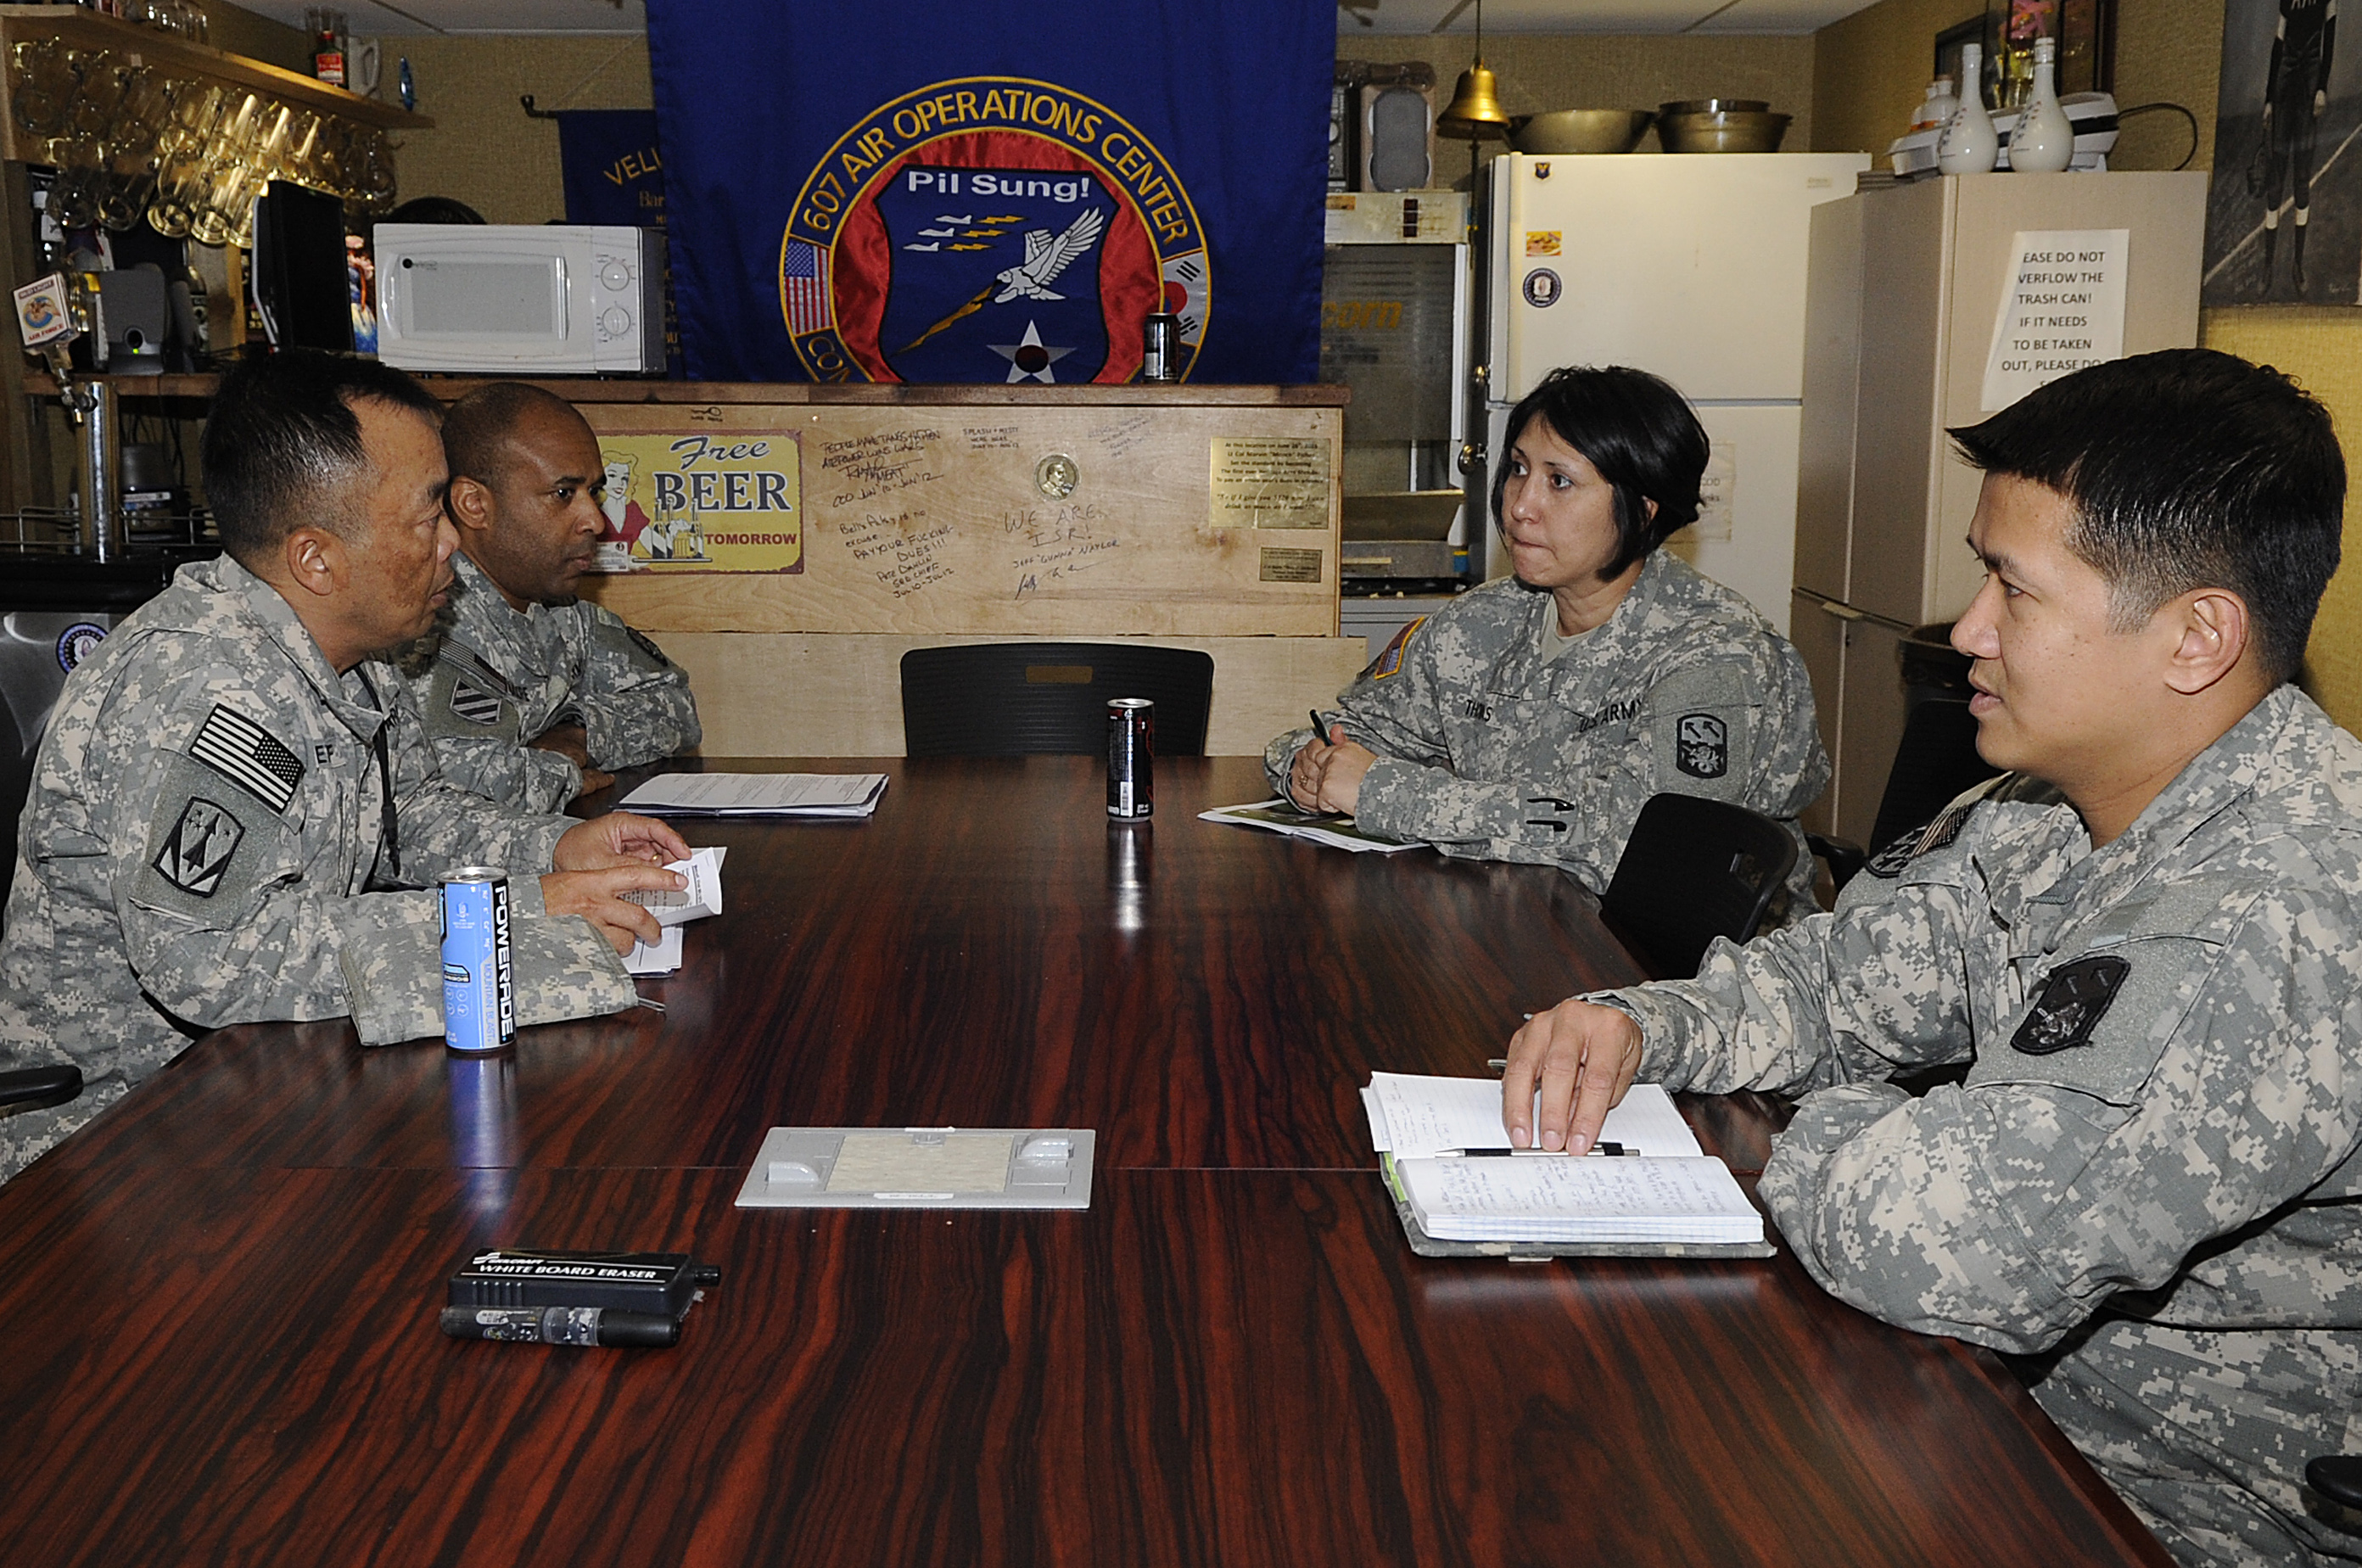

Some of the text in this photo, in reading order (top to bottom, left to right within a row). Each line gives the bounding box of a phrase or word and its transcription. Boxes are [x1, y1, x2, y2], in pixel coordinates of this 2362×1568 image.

[803, 88, 1189, 245] 607 AIR OPERATIONS CENTER
[908, 171, 1090, 204] Pil Sung!
[2056, 252, 2075, 263] DO
[2079, 251, 2106, 263] NOT
[2080, 272, 2105, 283] THE
[2018, 294, 2092, 305] TRASH CAN!
[2019, 316, 2088, 328] IF IT NEEDS
[2013, 339, 2092, 350] TO BE TAKEN
[2001, 361, 2032, 372] OUT,
[2035, 360, 2079, 371] PLEASE
[669, 435, 771, 471] Free
[653, 472, 792, 512] BEER
[1005, 509, 1038, 534] WE
[704, 533, 798, 545] TOMORROW
[495, 885, 514, 1038] POWERADE
[484, 964, 495, 1039] MOUNTAIN BLAST
[479, 1265, 657, 1280] WHITE BOARD ERASER
